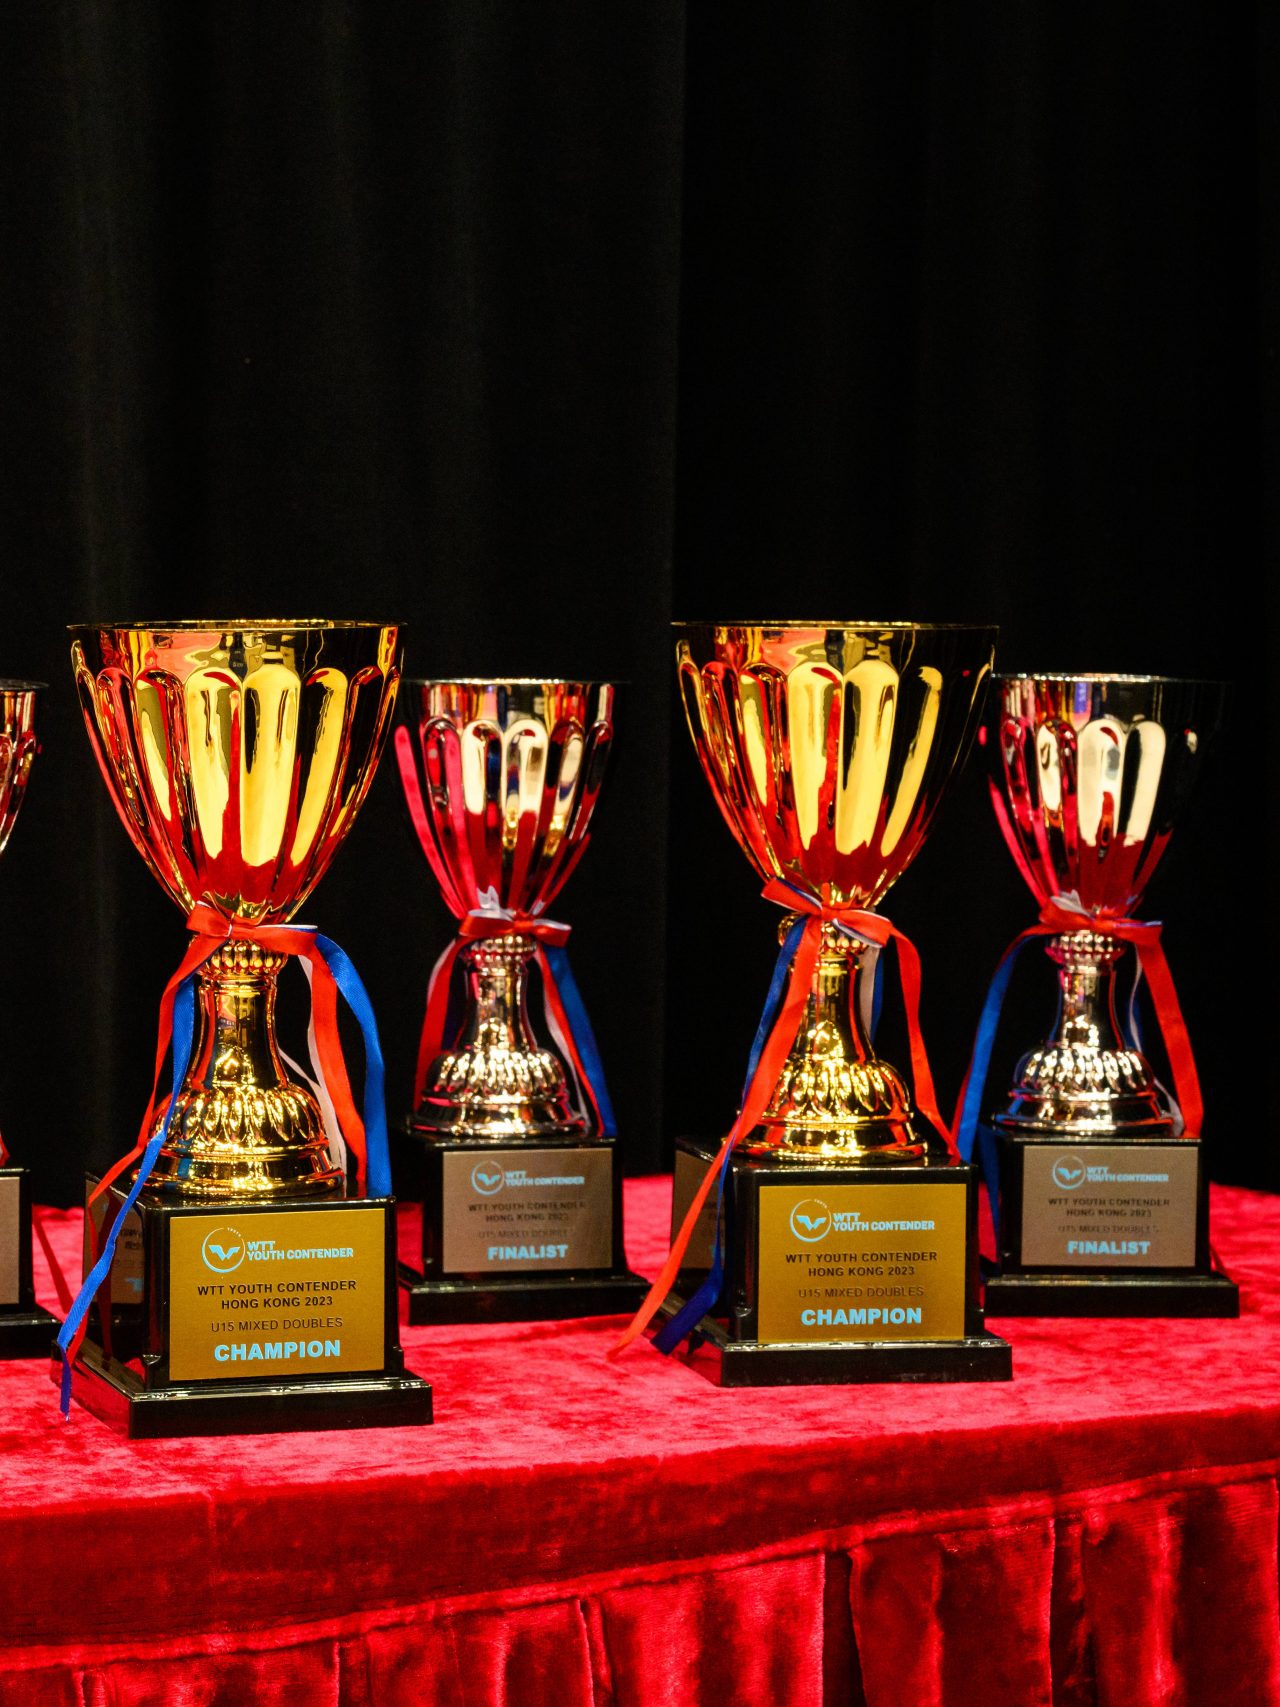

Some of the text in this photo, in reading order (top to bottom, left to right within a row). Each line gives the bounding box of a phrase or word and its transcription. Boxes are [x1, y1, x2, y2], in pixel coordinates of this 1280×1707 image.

[505, 1171, 526, 1179] WTT
[468, 1204, 488, 1212] WTT
[492, 1203, 524, 1211] YOUTH
[1067, 1209, 1095, 1217] HONG
[486, 1214, 514, 1222] HONG
[833, 1213, 860, 1222] WTT
[833, 1221, 935, 1231] YOUTH CONTENDER
[247, 1241, 275, 1251] WTT
[1068, 1241, 1150, 1254] FINALIST
[247, 1248, 353, 1261] YOUTH CONTENDER
[487, 1244, 568, 1260] FINALIST
[786, 1252, 937, 1263] WTT YOUTH CONTENDER
[809, 1266, 914, 1277] HONG KONG 2023
[198, 1280, 356, 1295] WTT YOUTH CONTENDER
[799, 1287, 924, 1298] U15 MIXED DOUBLES
[222, 1296, 333, 1309] HONG KONG 2023
[801, 1308, 921, 1325] CHAMPION
[212, 1318, 342, 1332] U15 MIXED DOUBLES
[214, 1340, 340, 1361] CHAMPION
